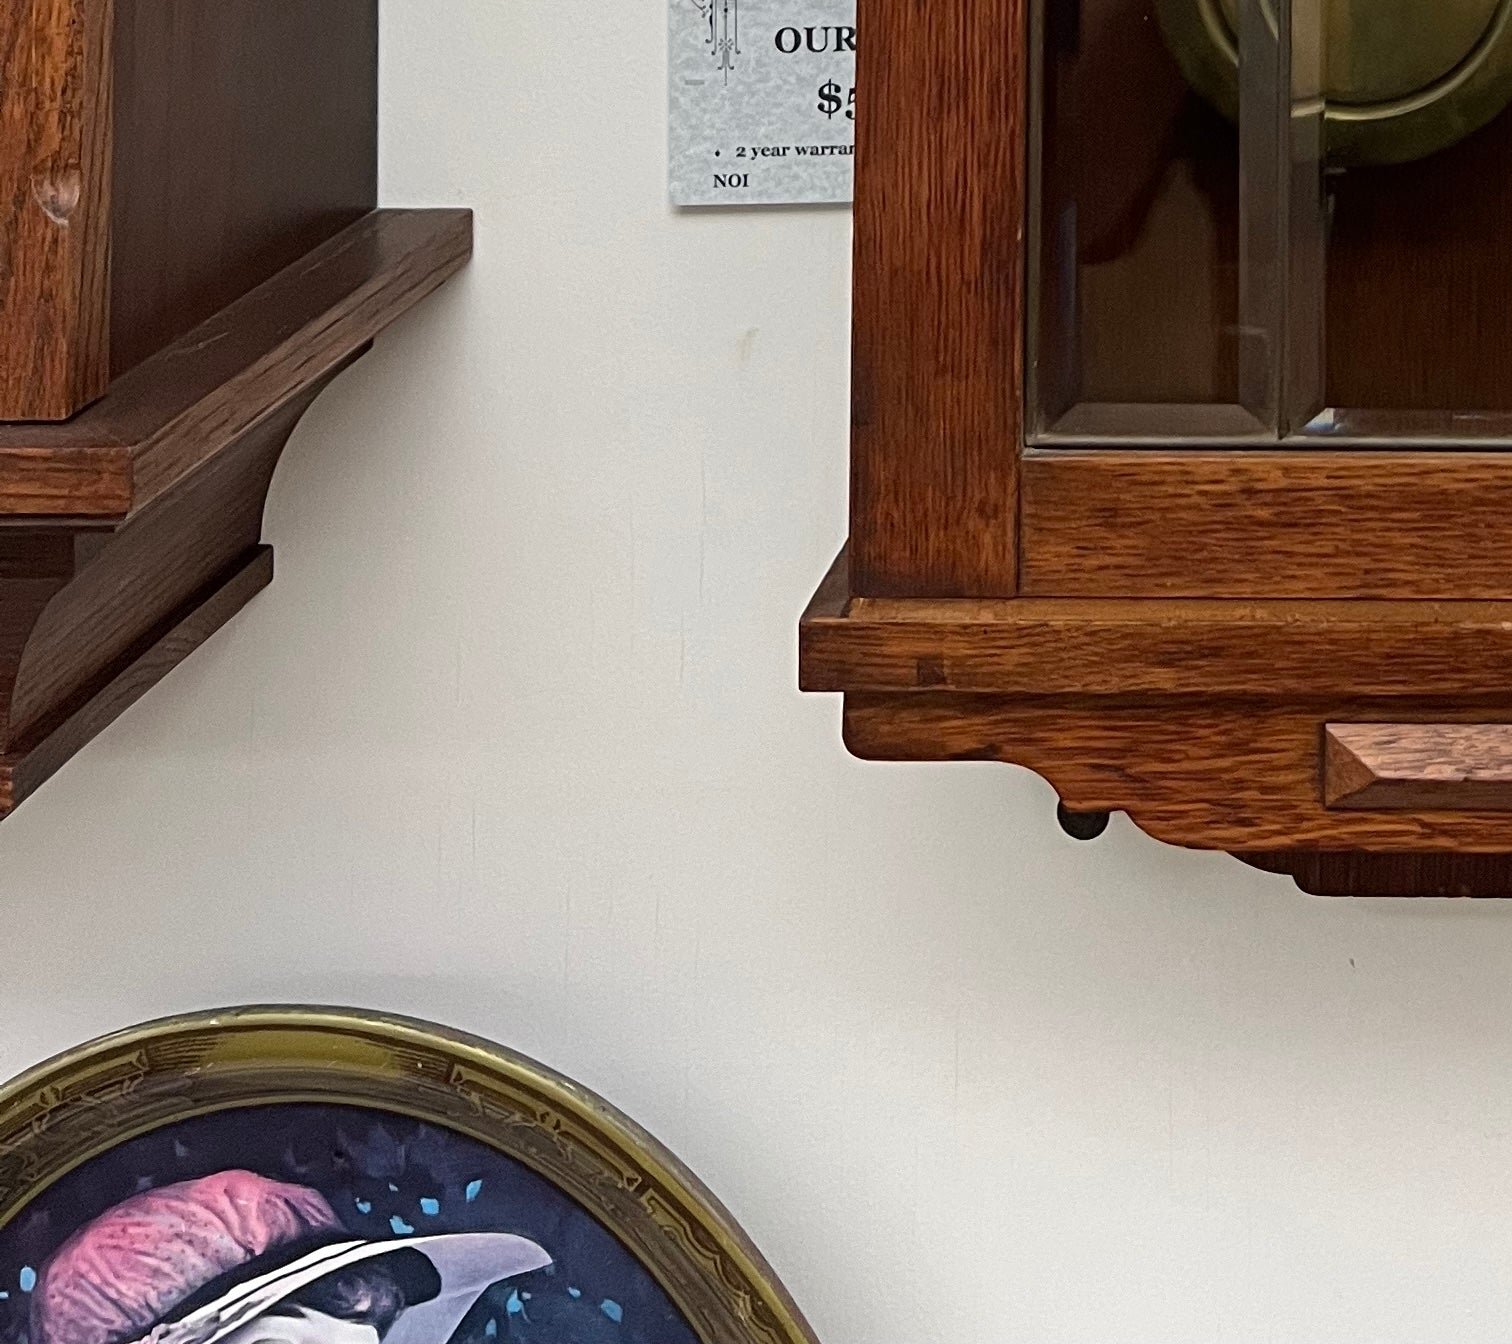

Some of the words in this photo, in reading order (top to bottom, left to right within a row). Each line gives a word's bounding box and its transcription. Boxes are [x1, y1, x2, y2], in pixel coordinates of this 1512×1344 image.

[775, 26, 857, 53] OUR
[736, 146, 747, 158] 2
[751, 146, 791, 160] year
